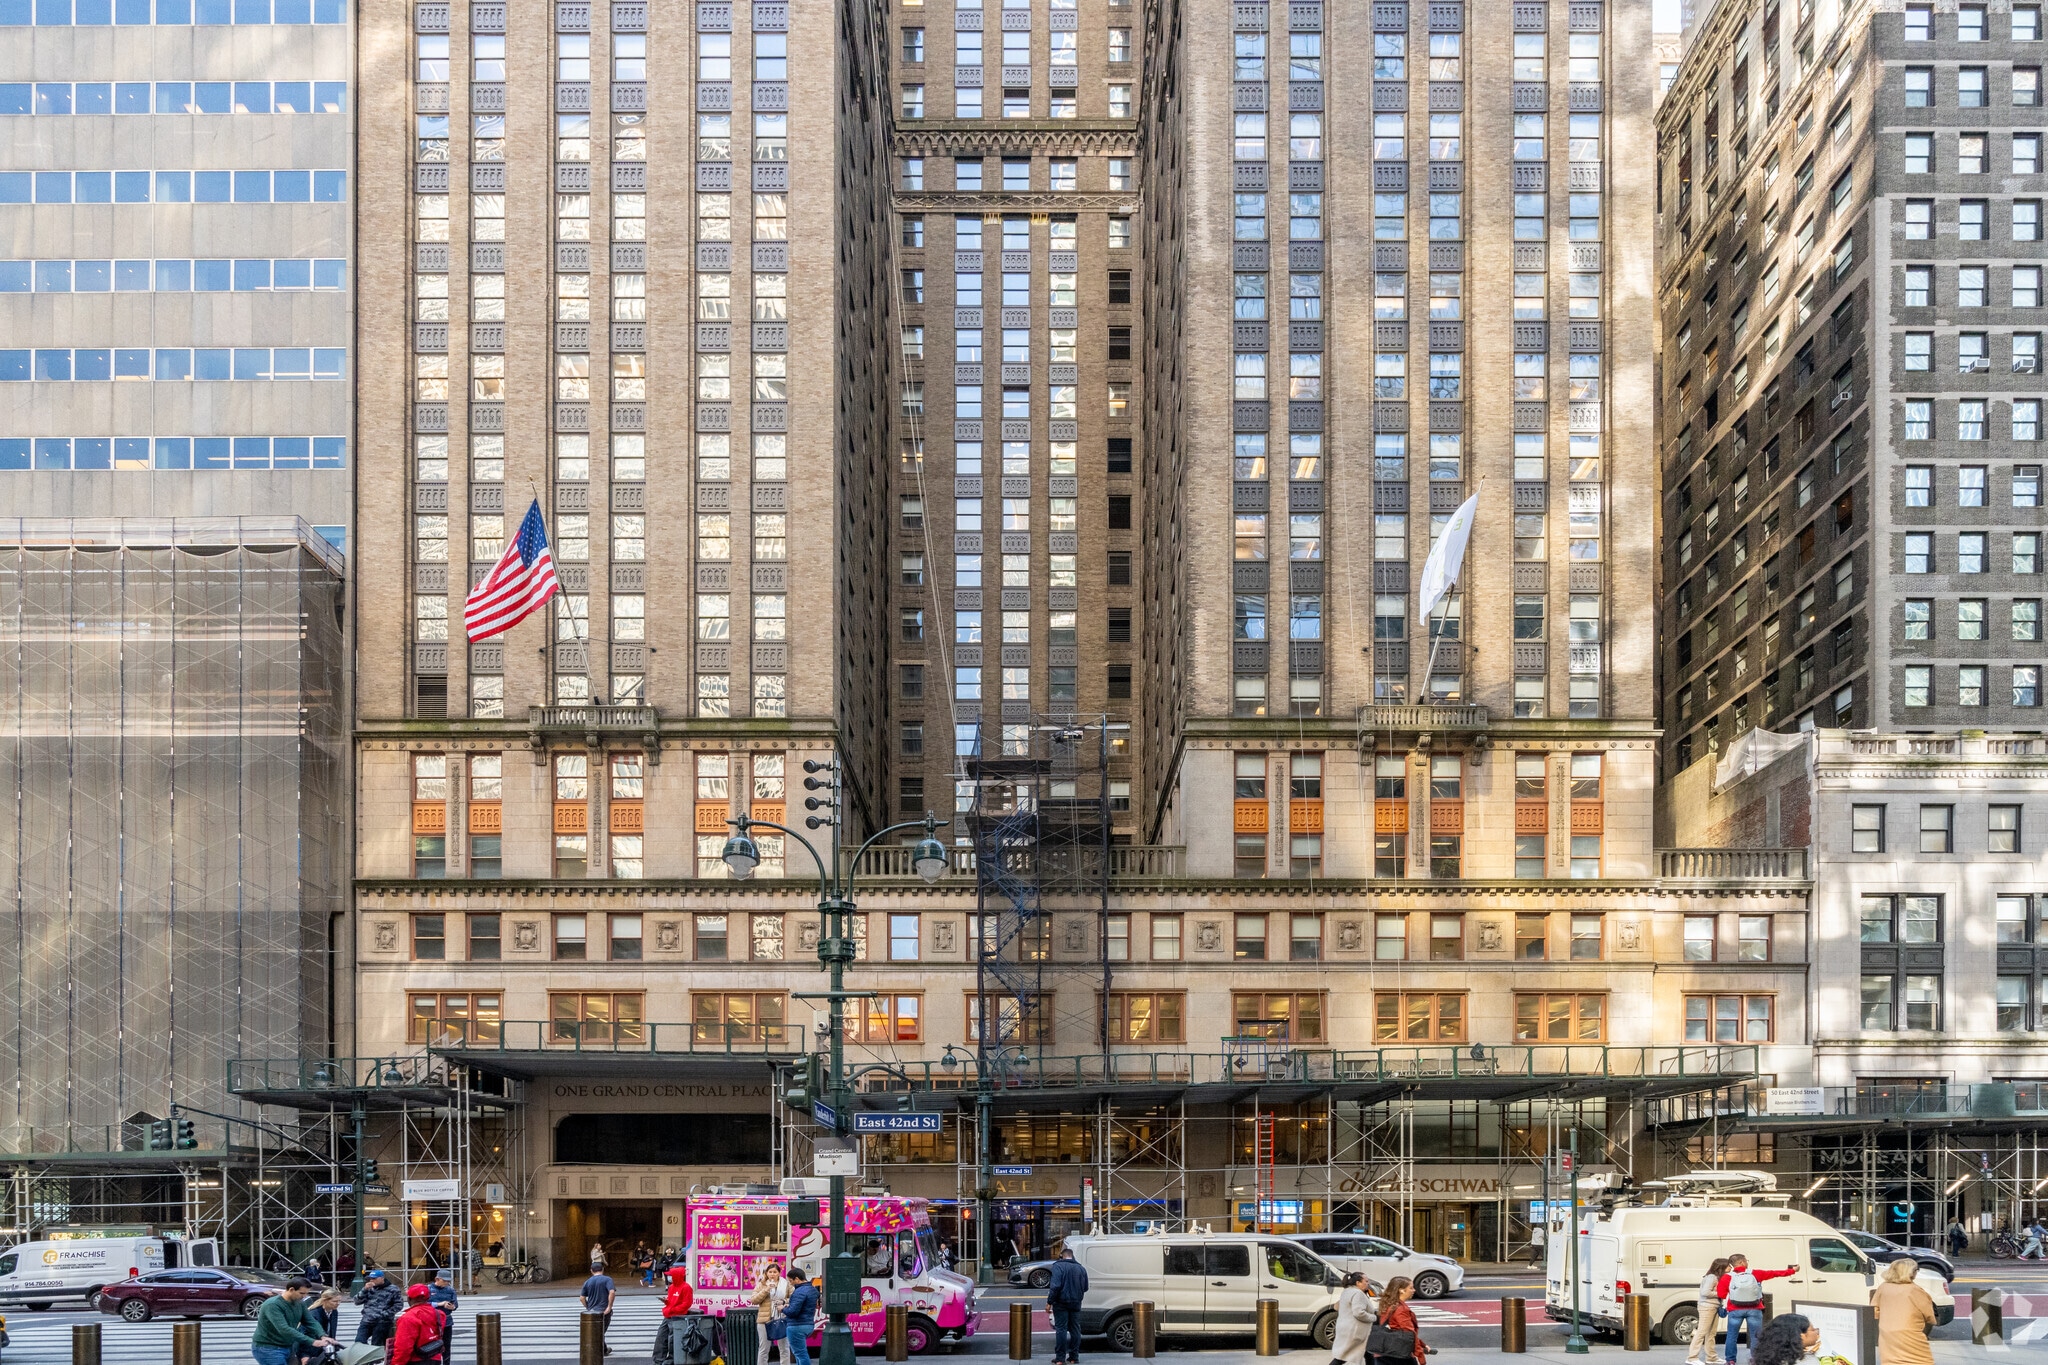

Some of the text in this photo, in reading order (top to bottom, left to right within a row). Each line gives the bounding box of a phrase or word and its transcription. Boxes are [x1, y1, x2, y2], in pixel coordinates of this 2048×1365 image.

[555, 1085, 778, 1097] ONE GRAND CENTRAL PLAC
[858, 1117, 936, 1128] East 42nd St
[666, 1215, 679, 1225] 60
[59, 1250, 106, 1258] FRANCHISE
[721, 1298, 738, 1306] CUPS
